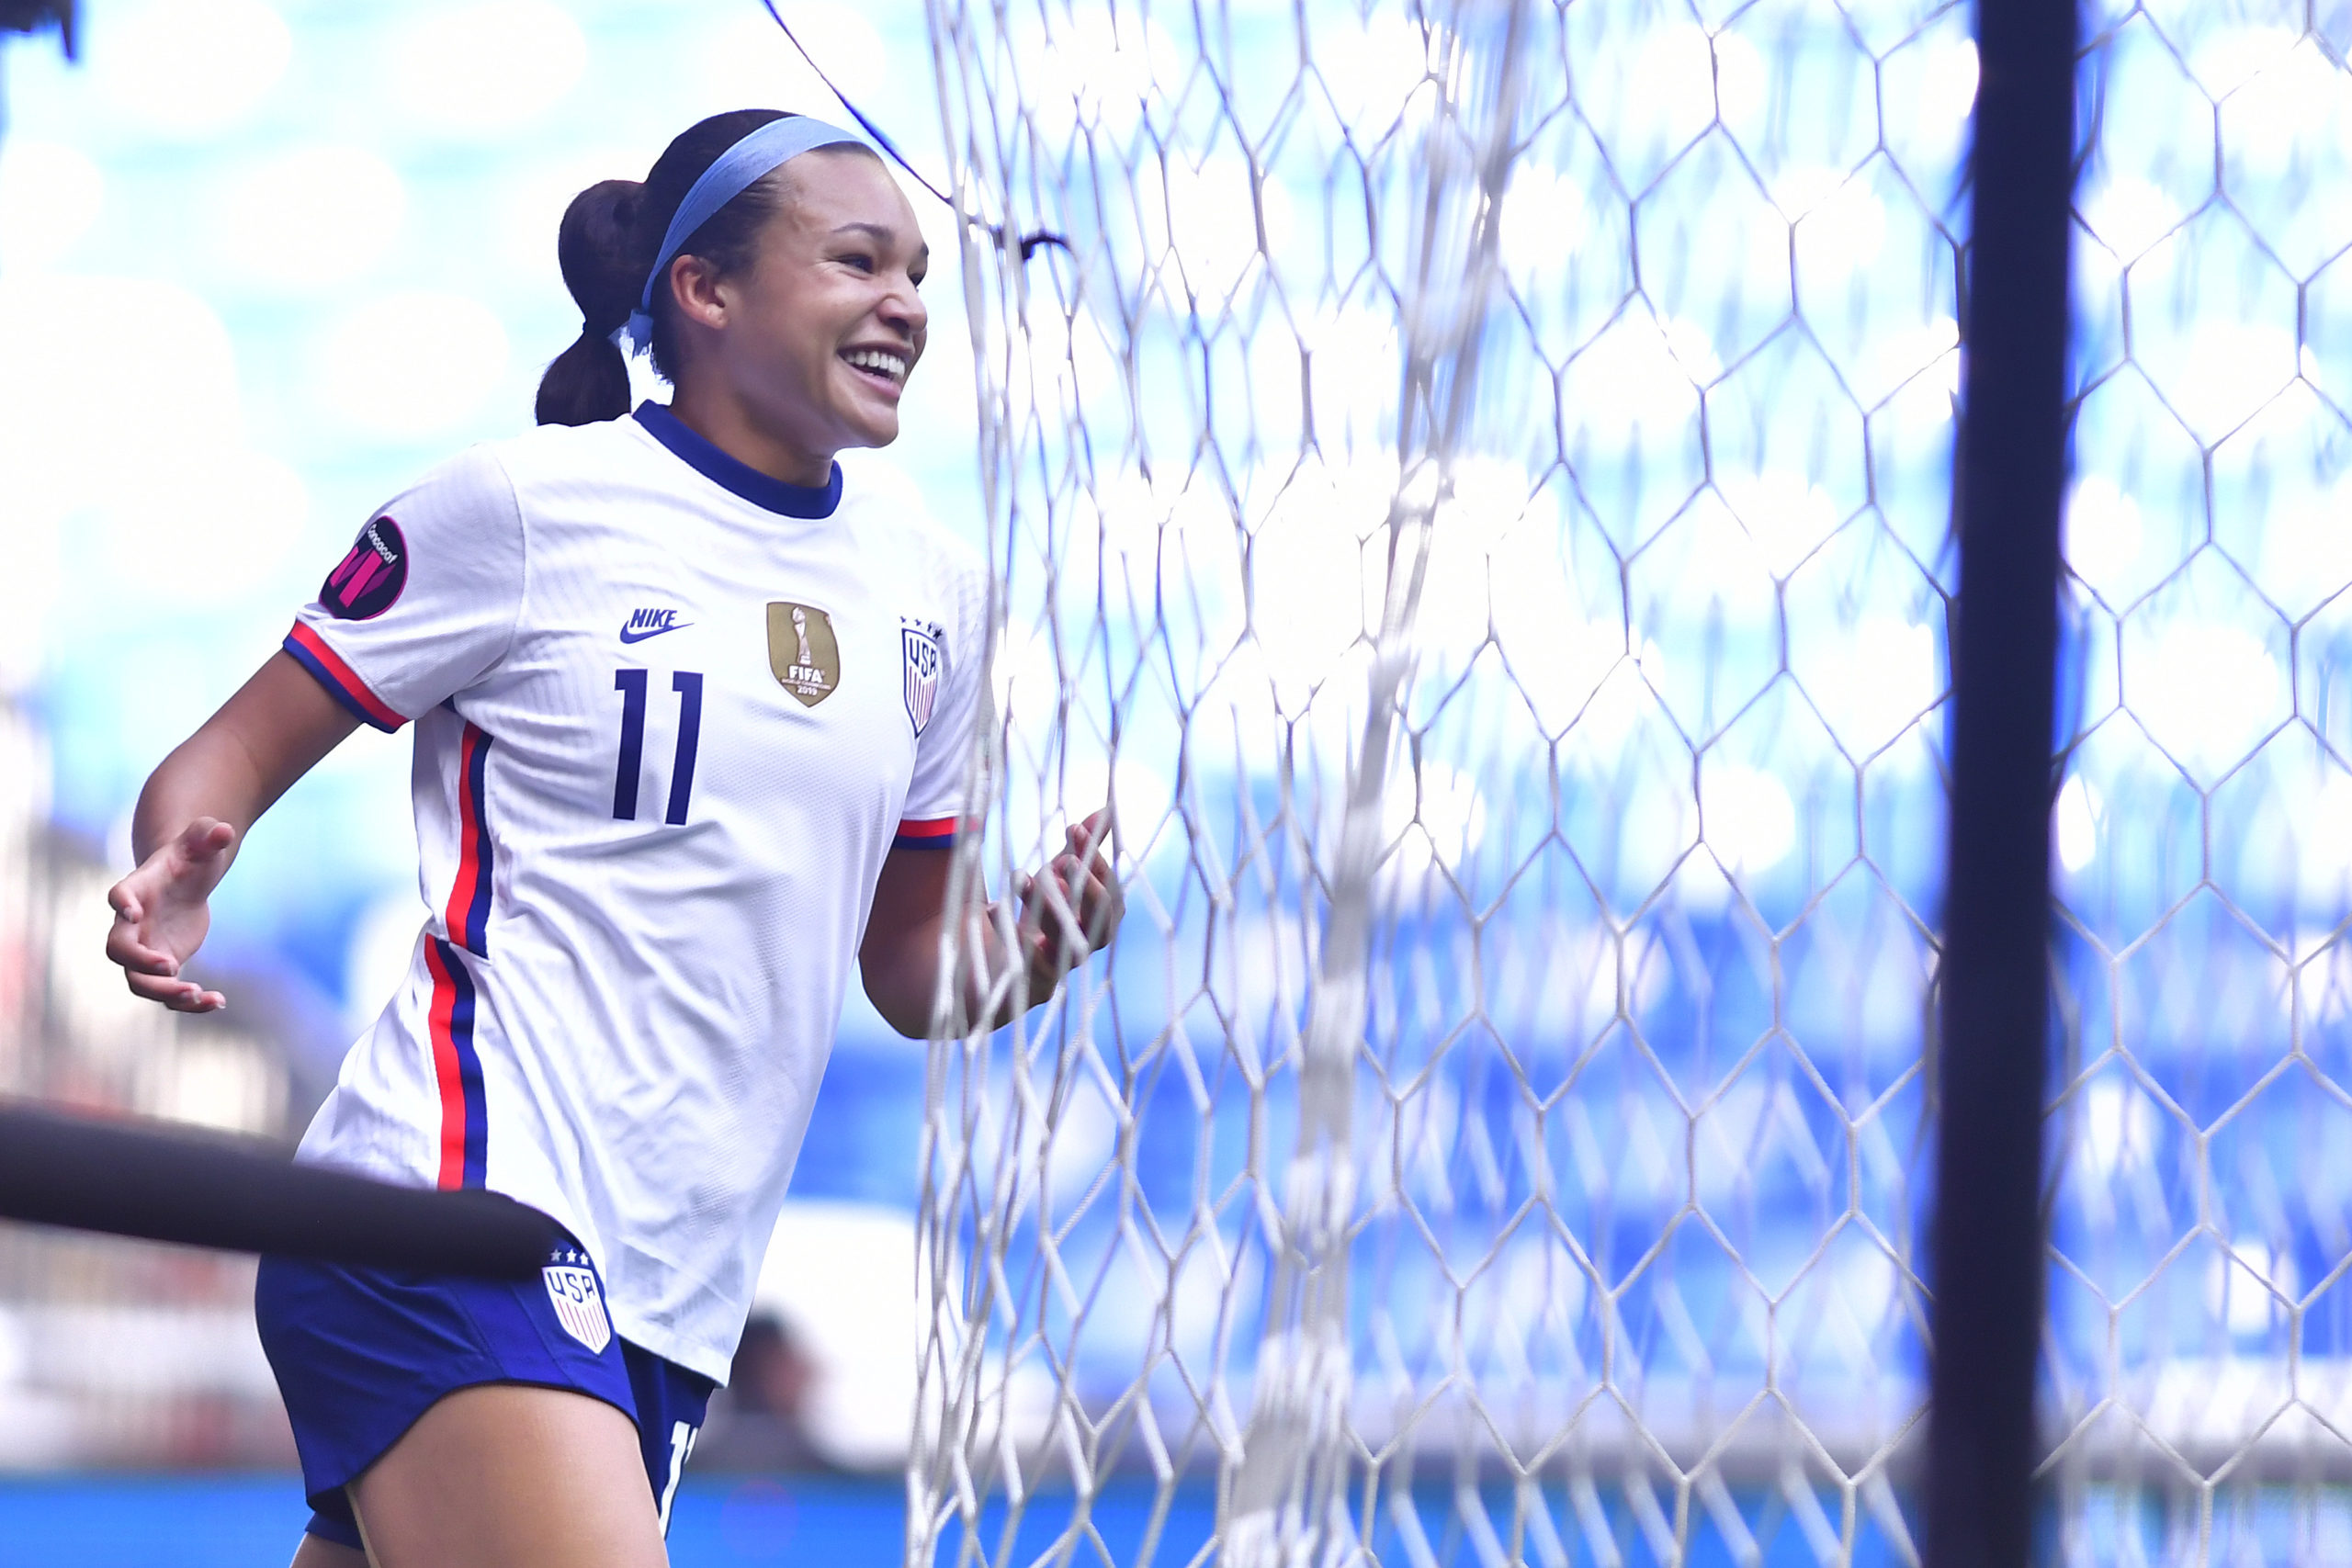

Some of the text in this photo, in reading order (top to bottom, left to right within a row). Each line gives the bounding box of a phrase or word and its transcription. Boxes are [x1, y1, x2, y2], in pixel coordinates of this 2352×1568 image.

[629, 608, 678, 628] NIKE
[909, 637, 936, 678] USA
[788, 665, 823, 683] FIFA
[797, 685, 819, 696] 2019
[613, 668, 704, 826] 11
[546, 1270, 595, 1303] USA
